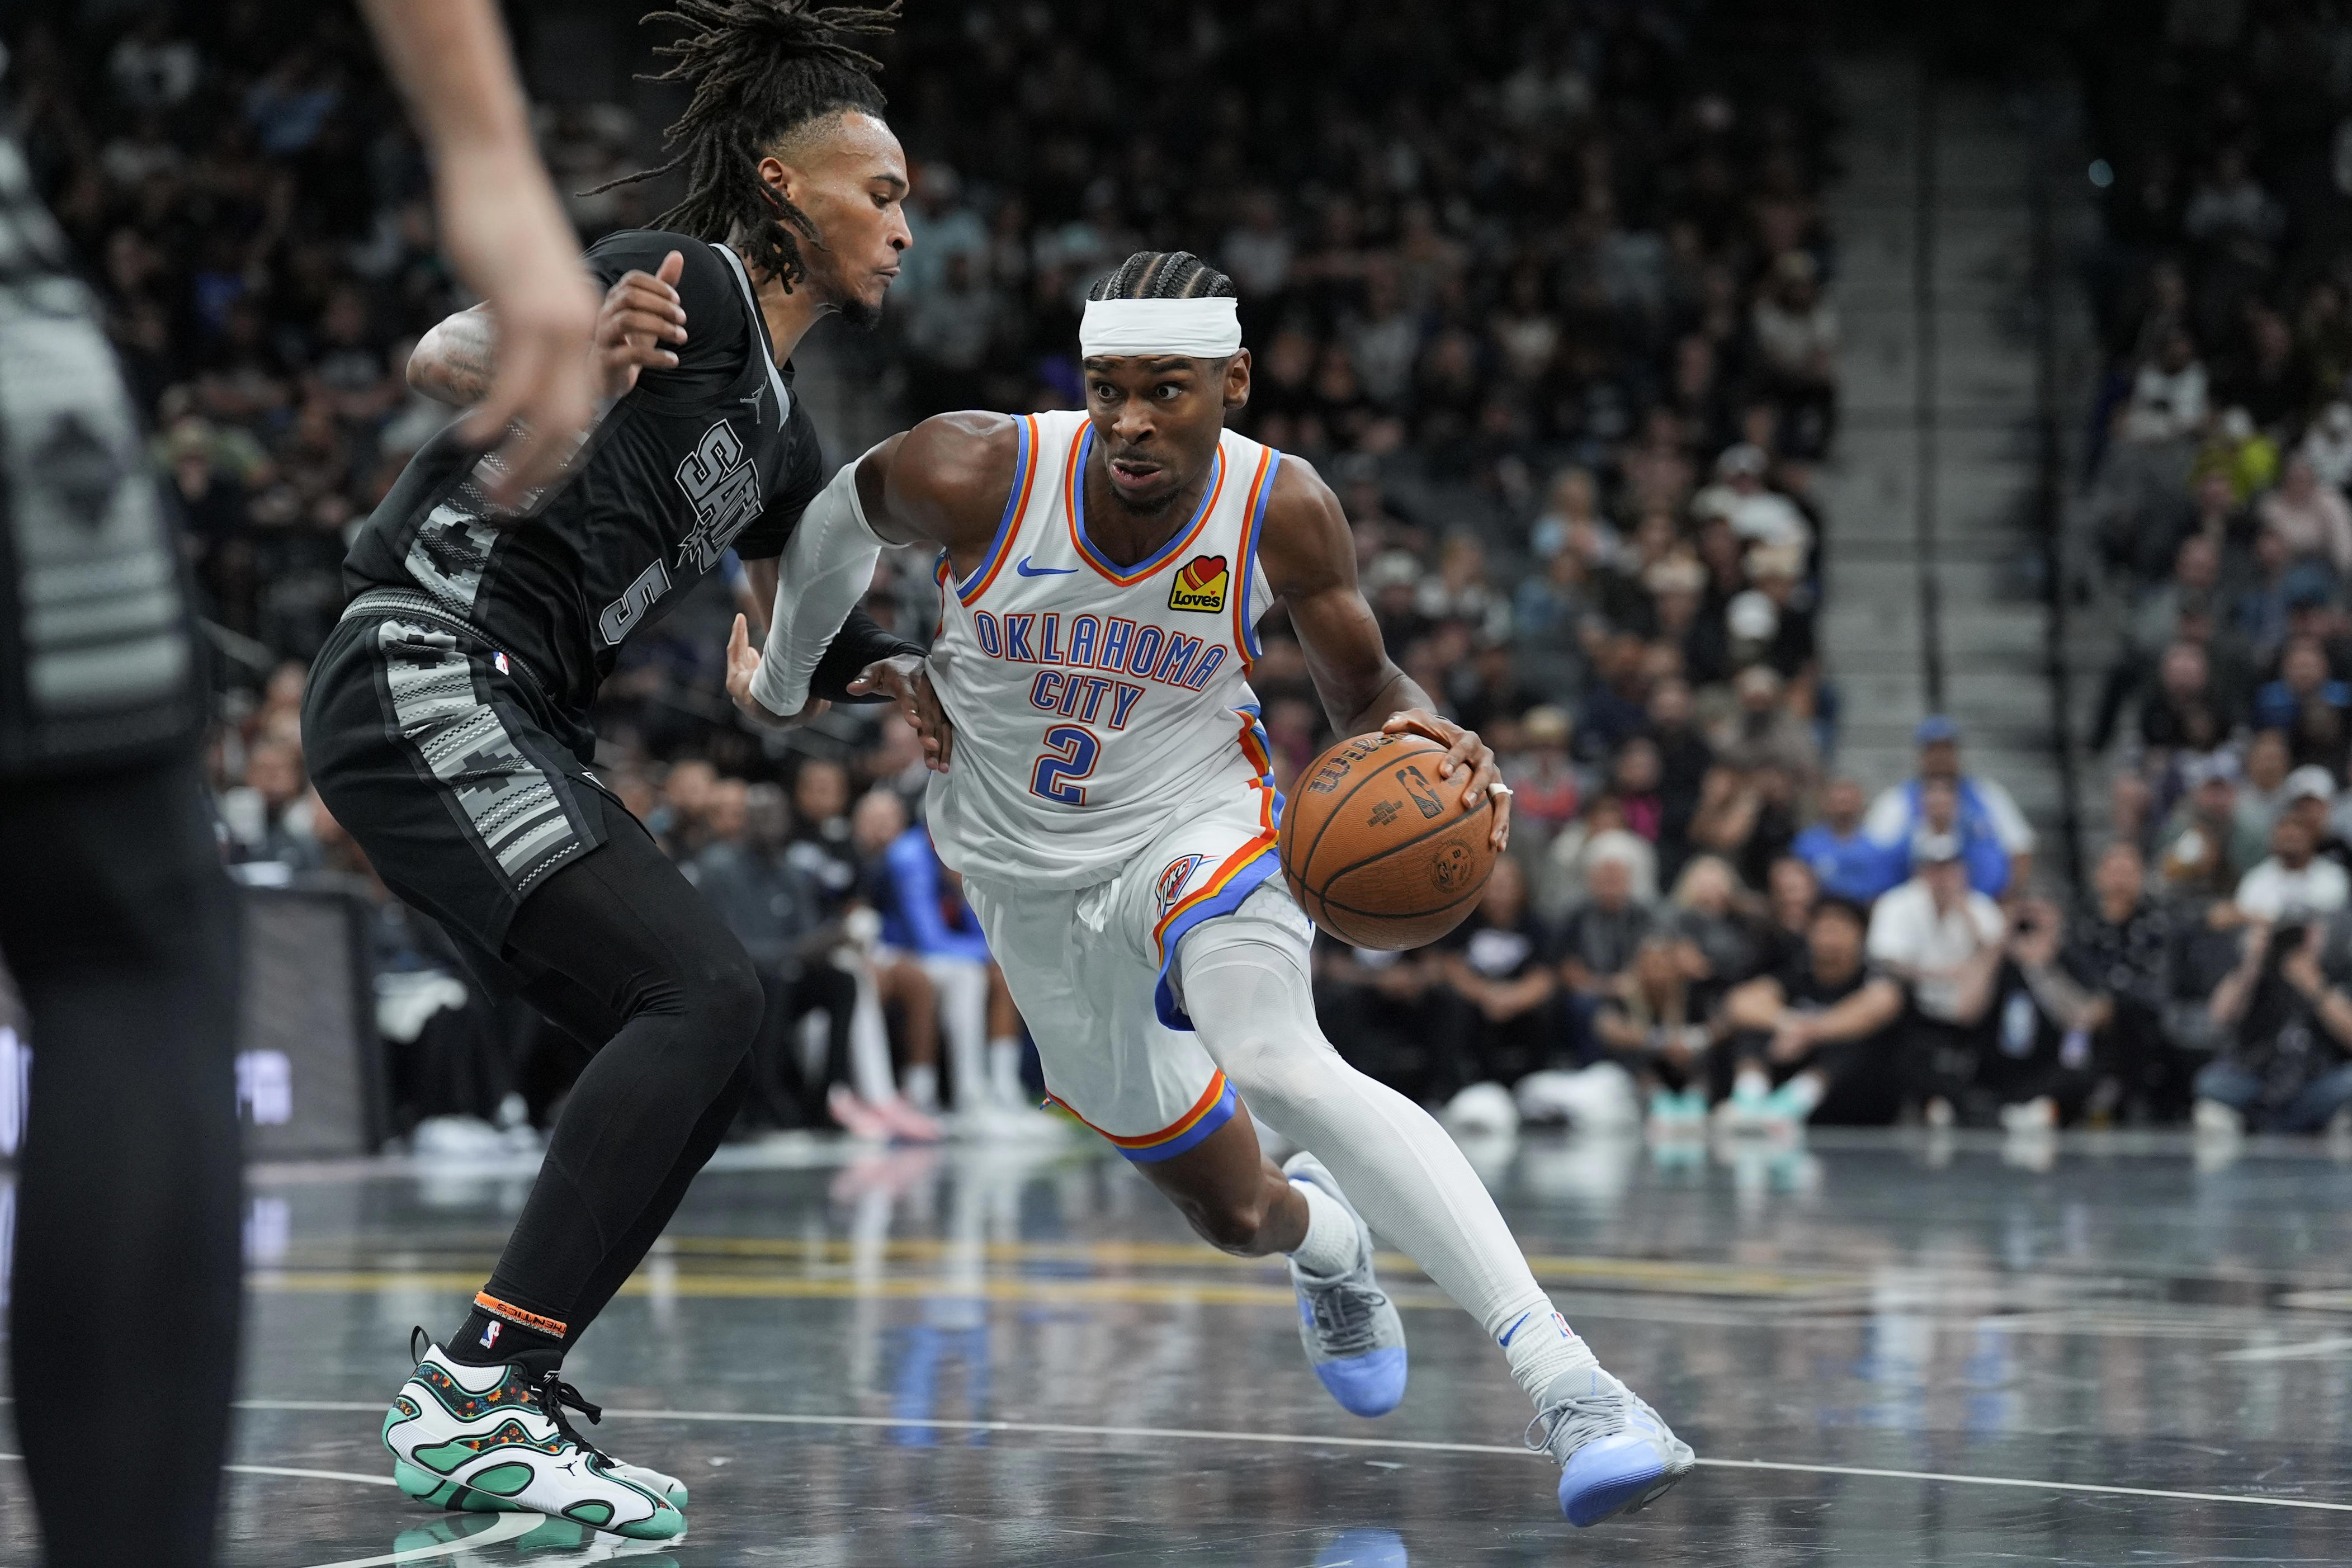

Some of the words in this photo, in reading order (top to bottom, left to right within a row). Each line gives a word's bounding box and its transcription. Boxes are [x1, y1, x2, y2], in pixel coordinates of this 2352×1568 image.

[598, 558, 672, 645] 5
[974, 610, 1227, 692] OKLAHOMA
[1029, 670, 1146, 730] CITY
[1029, 724, 1101, 806] 2
